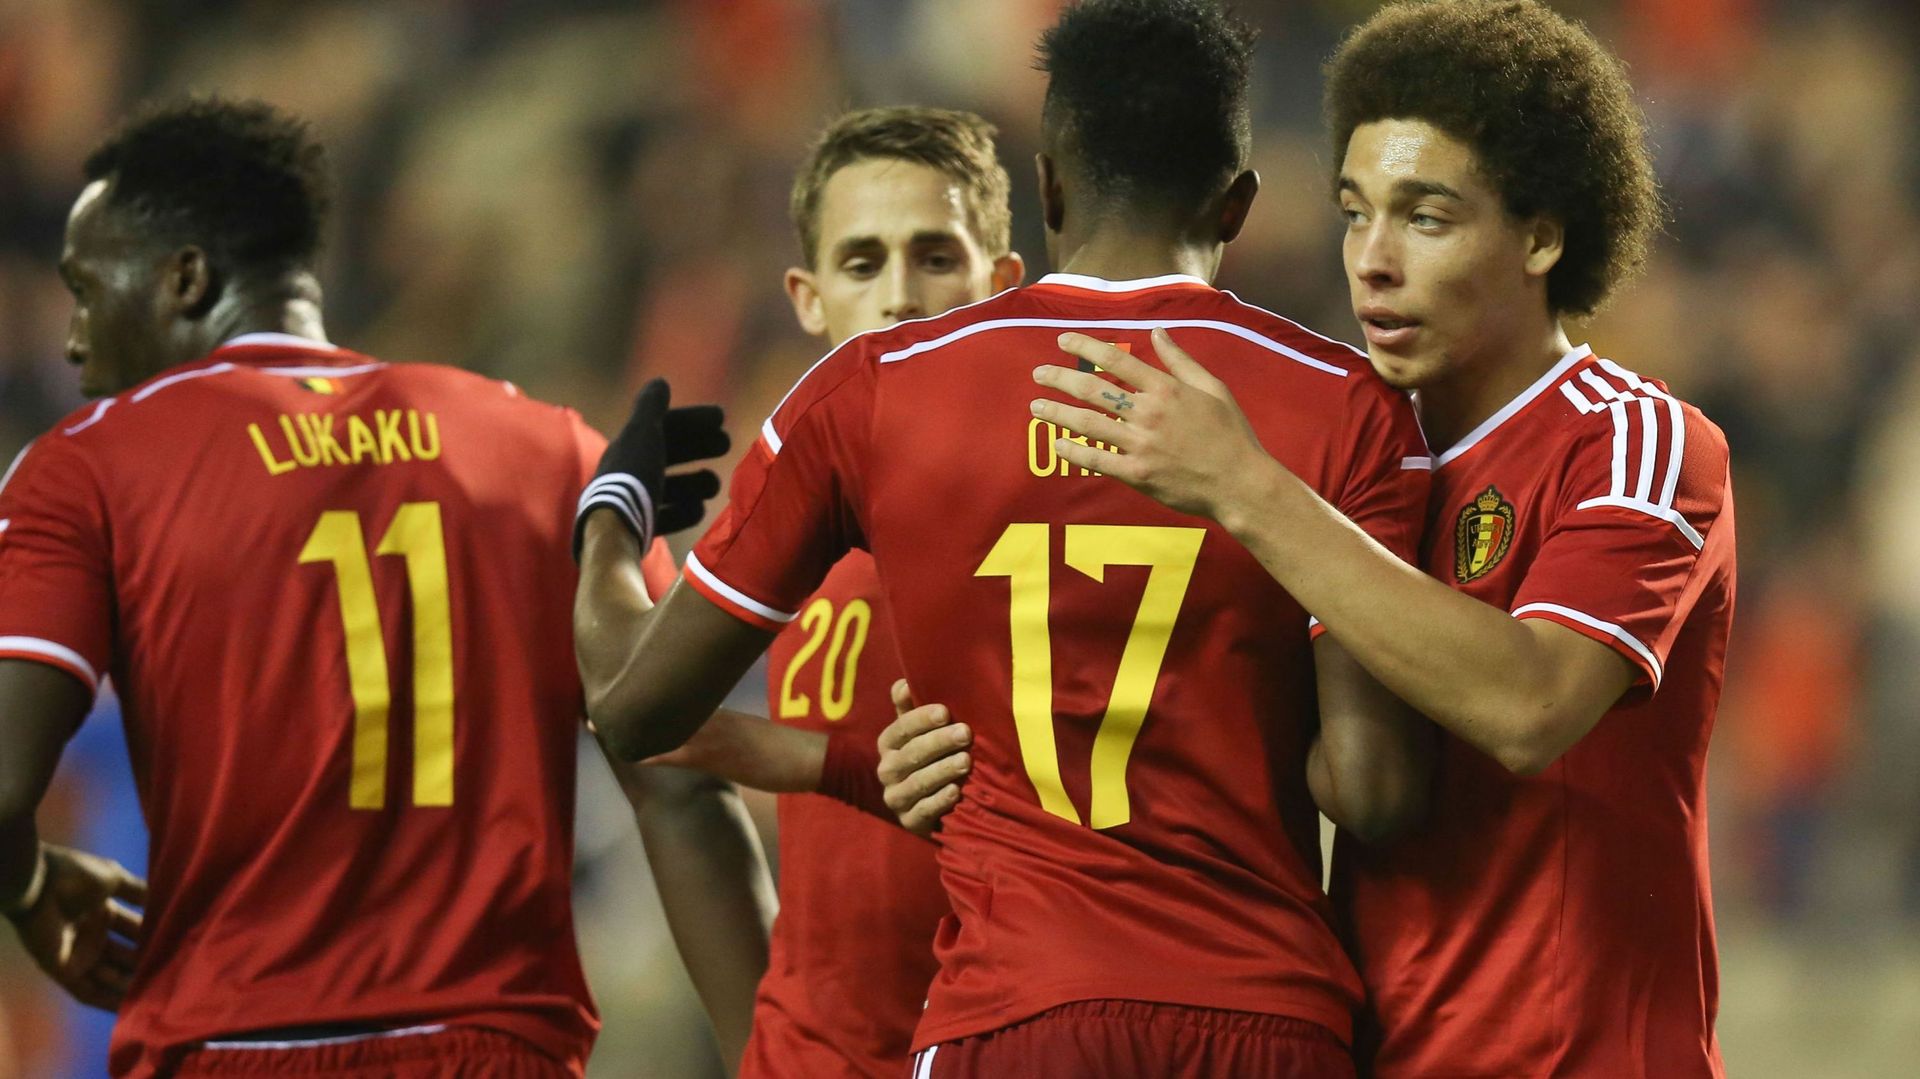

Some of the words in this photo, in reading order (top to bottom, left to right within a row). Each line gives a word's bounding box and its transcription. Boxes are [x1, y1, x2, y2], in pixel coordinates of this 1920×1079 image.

[248, 409, 442, 476] LUKAKU
[298, 502, 456, 808] 11
[779, 599, 872, 721] 20
[974, 523, 1207, 830] 17
